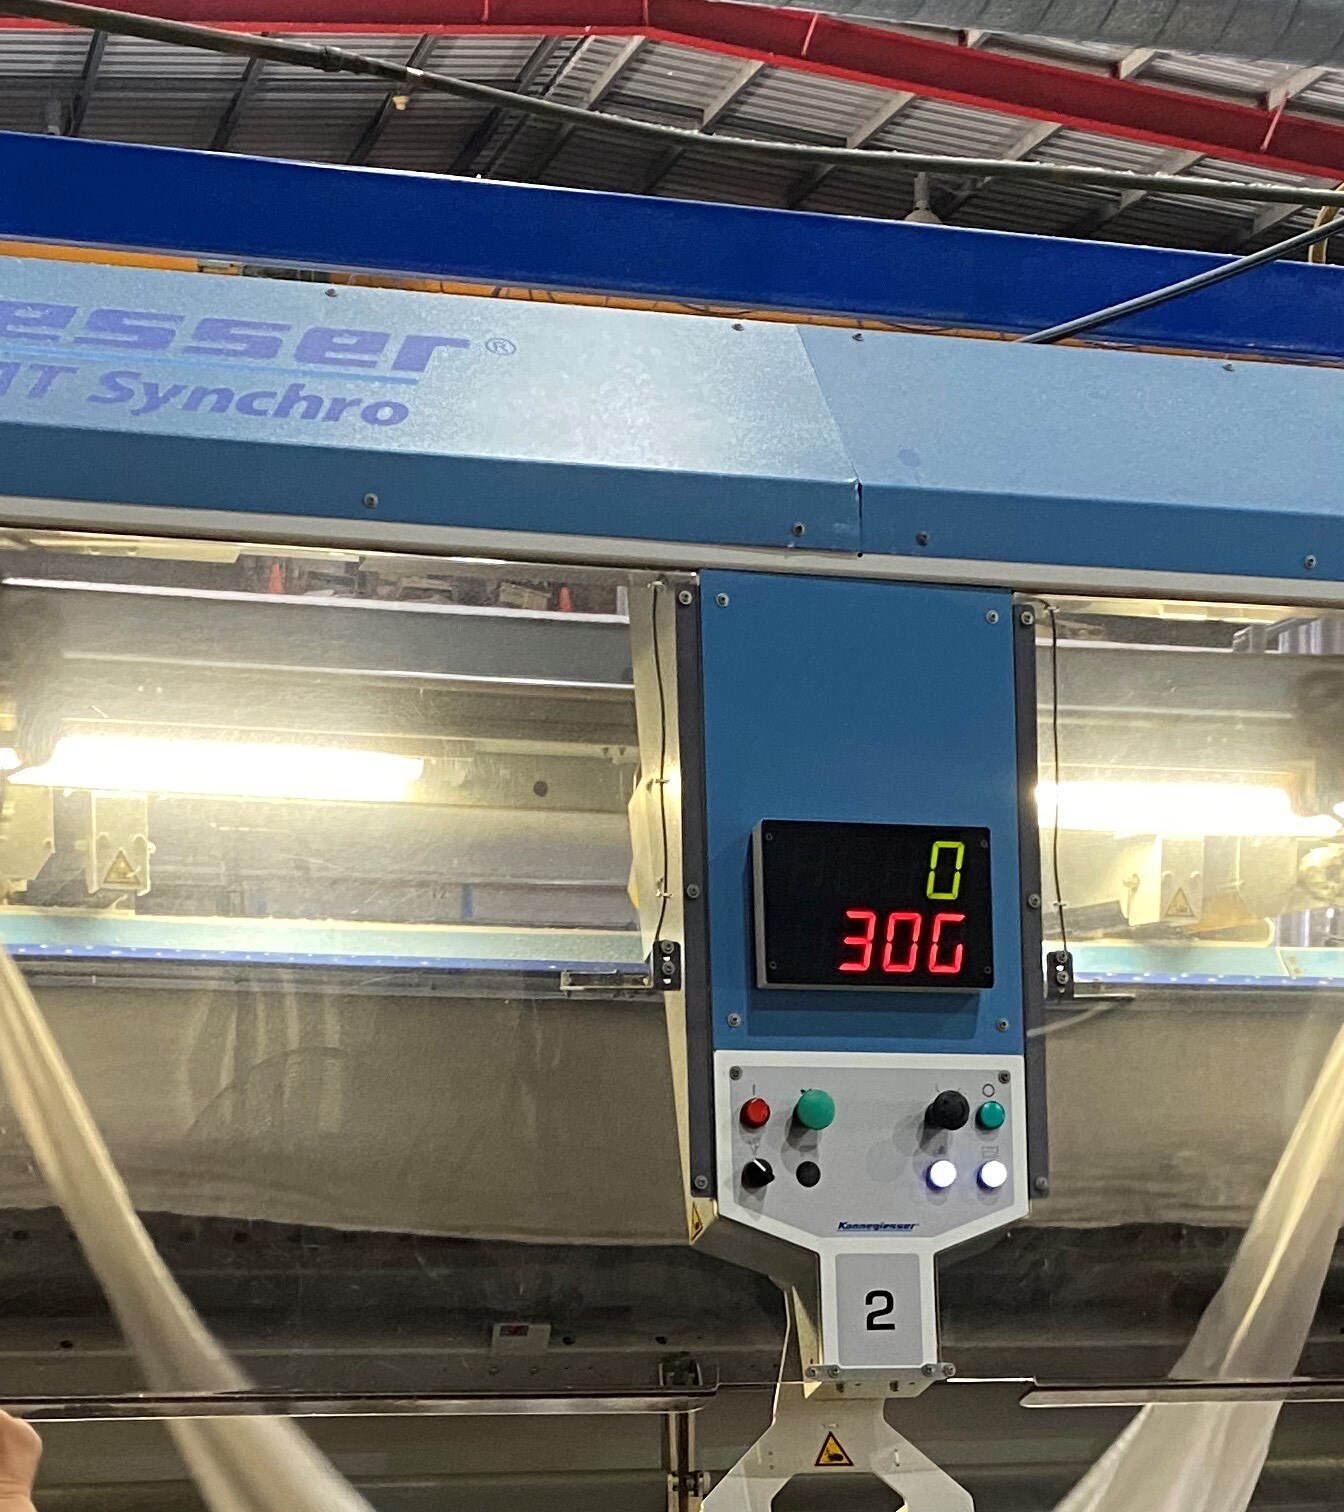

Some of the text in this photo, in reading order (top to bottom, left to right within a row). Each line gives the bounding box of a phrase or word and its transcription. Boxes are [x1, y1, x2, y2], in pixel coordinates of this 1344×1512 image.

[85, 370, 410, 427] Synchro
[925, 840, 965, 900] 0
[837, 1221, 919, 1231] Kannegiesser
[864, 1288, 897, 1332] 2
